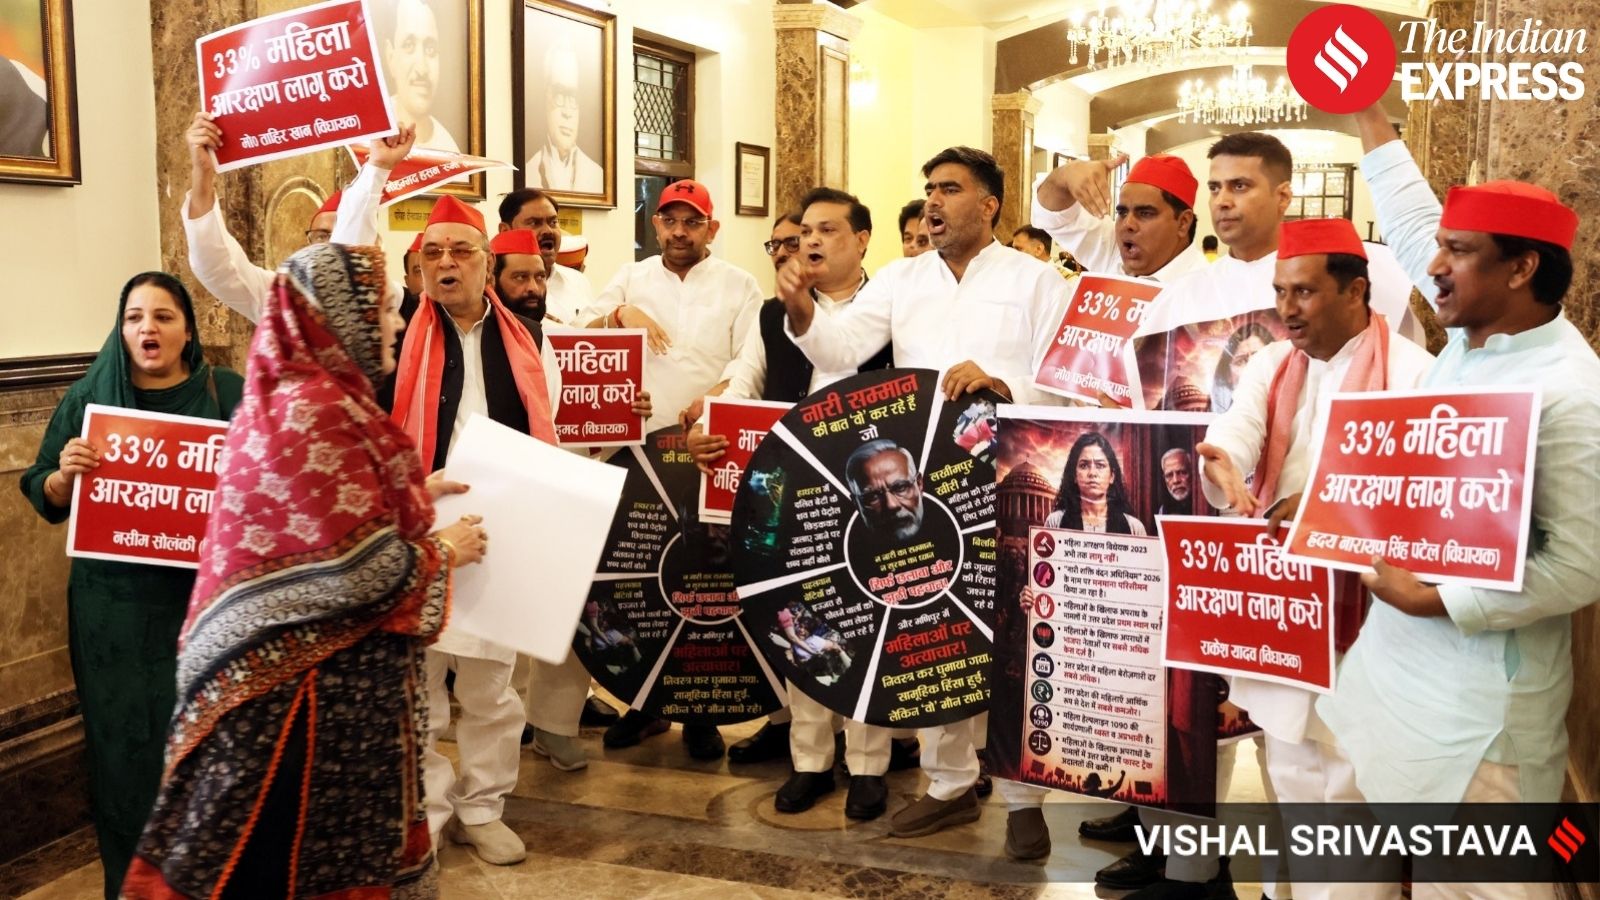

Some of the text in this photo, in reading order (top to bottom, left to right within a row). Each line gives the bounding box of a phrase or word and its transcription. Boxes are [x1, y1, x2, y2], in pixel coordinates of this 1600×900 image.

[213, 21, 352, 79] 33% महिला
[211, 56, 369, 118] आरक्षण लागू करो
[259, 127, 288, 147] ताहिर
[287, 123, 313, 139] खान
[313, 114, 362, 138] (विधायक)
[1077, 290, 1121, 320] 33%
[554, 340, 630, 375] महिला
[1058, 325, 1123, 357] आरक्षण
[562, 378, 636, 409] लागू करो
[800, 373, 918, 424] नारी सम्मान
[555, 420, 628, 437] हमद (विधायक)
[812, 421, 828, 437] की
[829, 418, 849, 432] बात
[869, 406, 889, 420] कर
[890, 398, 906, 415] रहे
[907, 394, 917, 411] हैं
[1340, 403, 1508, 459] 33% महिला
[859, 424, 879, 441] जो
[104, 433, 168, 469] 33%
[929, 459, 974, 481] लखीमपुर
[89, 476, 216, 514] आरक्षण ला
[935, 478, 959, 496] खीरी
[1319, 468, 1513, 519] आरक्षण लागू करो
[113, 529, 150, 548] नसीम
[152, 532, 196, 552] सोलंकी
[1064, 537, 1081, 548] महिला
[1130, 545, 1147, 554] 2023
[1180, 539, 1230, 572] 33%
[1339, 535, 1388, 557] नारायण
[1388, 534, 1410, 560] सिंह
[1411, 538, 1441, 561] पटेल
[1442, 539, 1500, 571] (विधायक)
[1143, 574, 1161, 582] 2026
[898, 619, 913, 630] और
[914, 612, 940, 625] मणिपुर
[1176, 584, 1323, 631] आरक्षण लागू करो
[884, 620, 973, 654] महिलाओं पर
[916, 666, 934, 679] कर
[936, 659, 966, 679] घुमाया
[1200, 638, 1301, 673] राकेश यादव (विधायक)
[888, 707, 920, 722] लेकिन
[940, 696, 961, 710] मौन
[962, 689, 984, 704] साधे
[897, 683, 940, 702] सामूहिक
[941, 677, 965, 692] हिंसा
[1111, 721, 1128, 730] 1090
